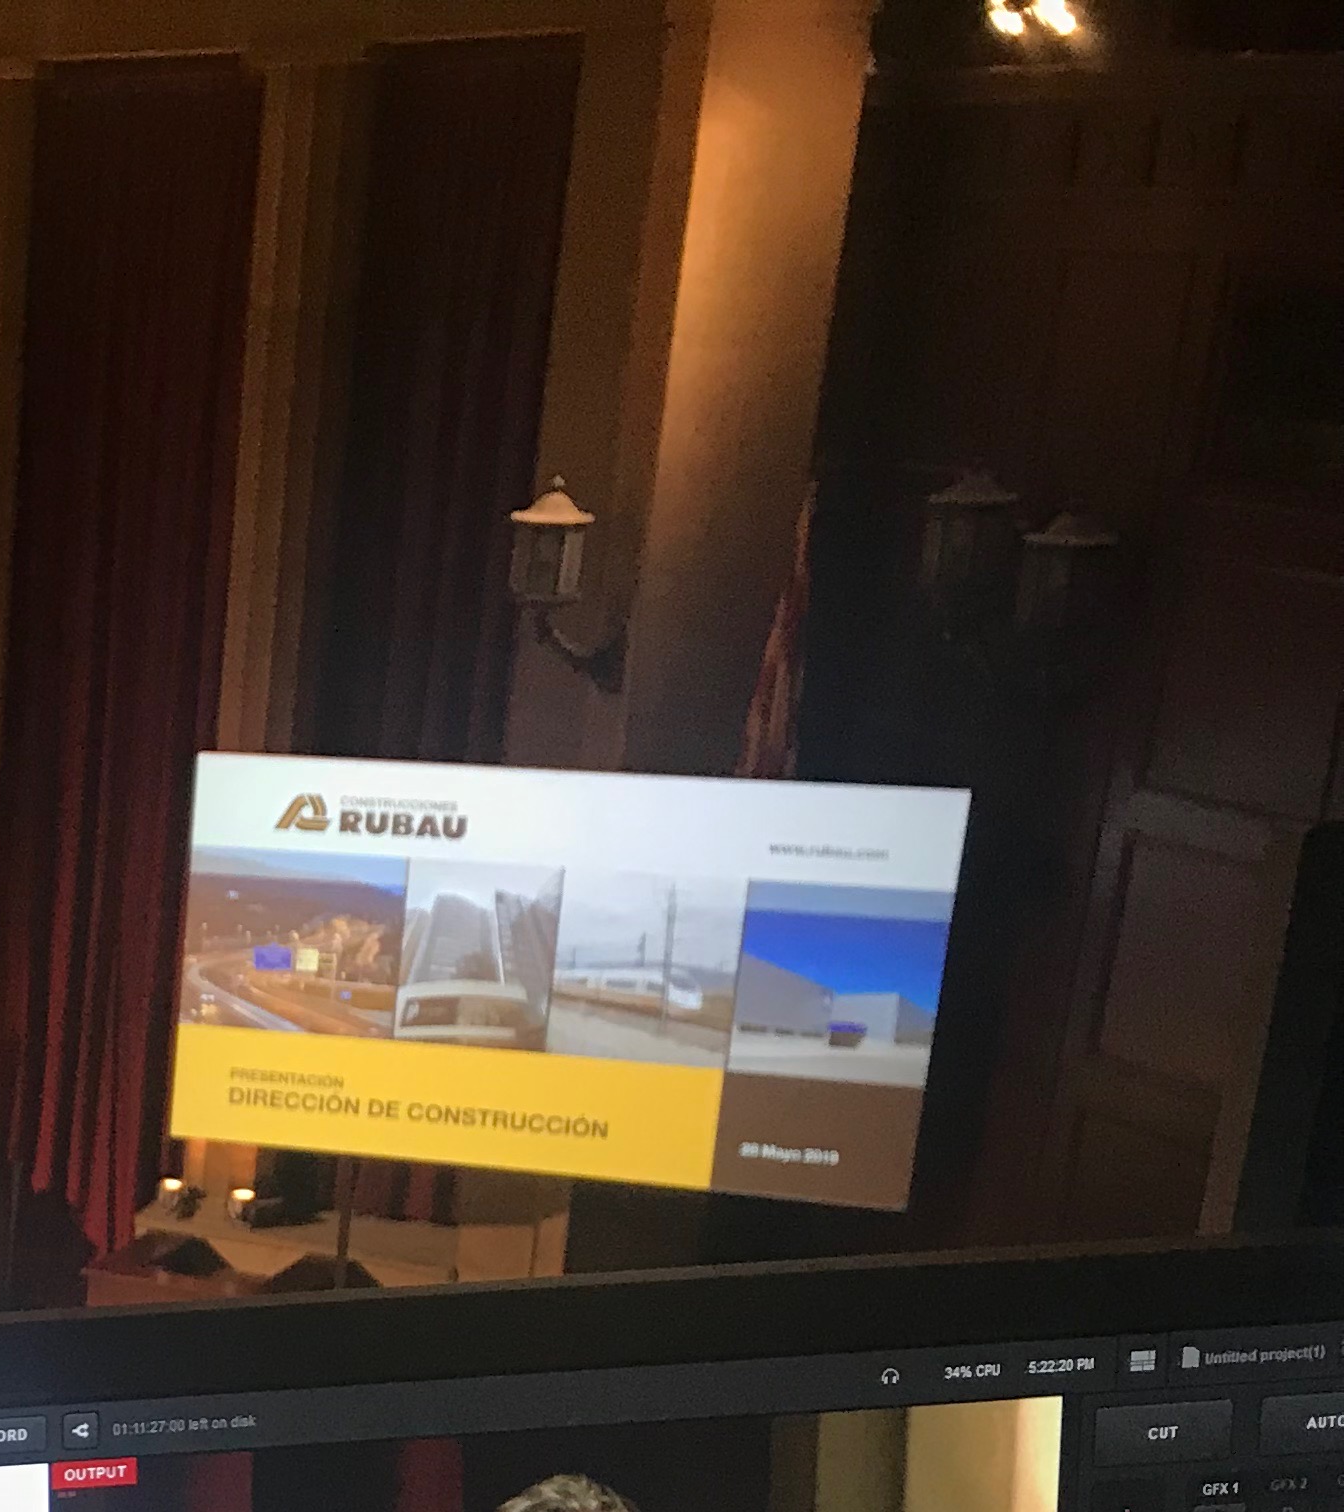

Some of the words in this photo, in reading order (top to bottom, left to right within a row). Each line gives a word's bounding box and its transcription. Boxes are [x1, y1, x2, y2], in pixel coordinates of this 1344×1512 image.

[339, 810, 468, 839] RUBAU
[229, 1066, 345, 1089] PRESENTACIÓN
[227, 1085, 361, 1115] DIRECCIÓN
[367, 1097, 401, 1119] DE
[407, 1101, 610, 1139] CONSTRUCCIÓN
[1028, 1358, 1075, 1375] 5:22:20
[1076, 1356, 1096, 1371] PM
[1205, 1349, 1258, 1365] Untitled
[944, 1365, 973, 1381] 34%
[976, 1363, 1001, 1378] CPU
[187, 1416, 211, 1432] left
[212, 1417, 227, 1431] on
[229, 1413, 257, 1429] disk
[1148, 1425, 1179, 1441] CUT
[63, 1464, 127, 1483] OUTPUT
[1202, 1481, 1229, 1497] GFX
[1232, 1480, 1241, 1495] 1
